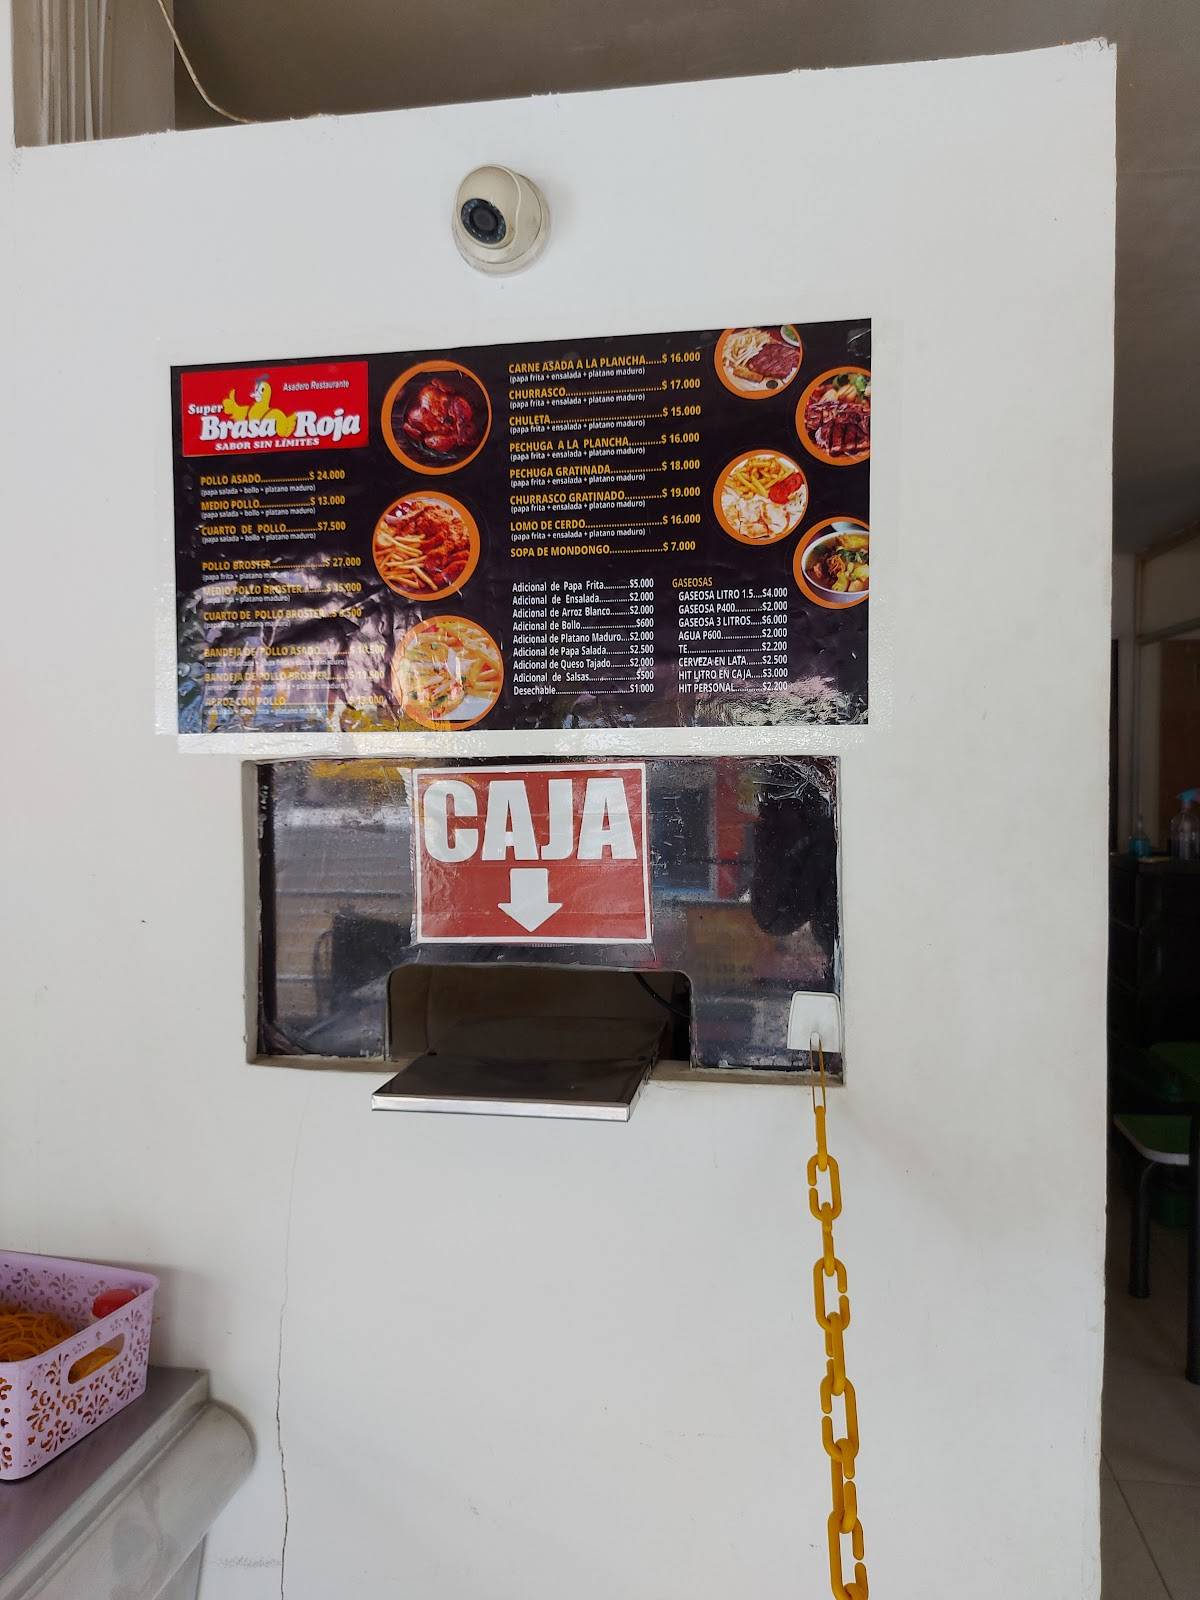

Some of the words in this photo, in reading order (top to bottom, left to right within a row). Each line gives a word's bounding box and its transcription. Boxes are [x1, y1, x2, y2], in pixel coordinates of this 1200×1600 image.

[509, 362, 541, 374] CARNE
[542, 360, 573, 372] ASADA
[576, 359, 584, 370] A
[586, 358, 598, 369] LA
[600, 355, 646, 368] PLANCHA
[670, 352, 701, 363] 16.000
[283, 383, 310, 392] Asadero
[311, 380, 350, 390] Restaurante
[509, 387, 566, 400] CHURRASCO
[670, 379, 701, 389] 17.000
[188, 404, 224, 415] Super
[509, 415, 551, 427] CHULETA
[671, 406, 702, 416] 15.000
[200, 415, 277, 441] Brasa
[294, 408, 360, 442] Roja
[215, 441, 252, 451] SABOR
[253, 440, 274, 449] SIN
[510, 441, 553, 453] PECHUGA
[558, 440, 564, 450] A
[567, 440, 579, 450] LA
[584, 436, 629, 449] PLANCHA
[669, 432, 700, 443] 16.000
[510, 467, 553, 479] PECHUGA
[555, 464, 611, 477] GRATINADA
[670, 460, 700, 470] 18.000
[200, 476, 229, 486] POLLO
[231, 474, 261, 485] ASADO
[317, 470, 346, 481] 24.000
[201, 501, 229, 511] MEDIO
[231, 500, 260, 510] POLLO
[318, 496, 346, 506] 13.000
[510, 494, 567, 506] CHURRASCO
[569, 491, 625, 503] GRATINADO
[670, 487, 701, 497] 19.000
[202, 526, 236, 536] CUARTO
[241, 525, 253, 533] DE
[258, 524, 286, 533] POLLO
[510, 521, 539, 532] LOMO
[540, 520, 553, 530] DE
[555, 519, 586, 529] CERDO
[671, 514, 701, 524] 16.000
[511, 548, 535, 558] SOPA
[537, 547, 549, 556] DE
[551, 545, 610, 556] MONDONGO
[671, 541, 696, 551] 7.000
[333, 558, 361, 567] 27.000
[512, 582, 547, 593] Adicional
[550, 580, 560, 592] de
[564, 581, 582, 593] Papa
[586, 580, 604, 590] Frita
[630, 578, 654, 589] $5.000
[672, 577, 713, 588] GASEOSAS
[512, 594, 547, 606] Adicional
[552, 594, 561, 605] de
[566, 593, 600, 604] Ensalada
[630, 592, 654, 602] $2.000
[678, 591, 715, 601] GASEOSA
[717, 590, 740, 600] LITRO
[742, 589, 753, 599] 1.5
[762, 588, 788, 598] $4.000
[513, 608, 547, 619] Adicional
[550, 607, 560, 617] de
[562, 608, 583, 617] Arroz
[585, 607, 611, 617] Blanco
[630, 605, 654, 615] $2.000
[678, 604, 715, 614] GASEOSA
[717, 603, 736, 613] P400
[762, 601, 788, 611] $2.000
[513, 620, 547, 632] Adicional
[550, 620, 560, 630] de
[562, 620, 582, 630] Bollo
[636, 618, 654, 628] $600
[678, 617, 715, 628] GASEOSA
[716, 617, 721, 627] 3
[723, 616, 751, 626] LITROS
[762, 614, 788, 624] $6.000
[513, 634, 547, 644] Adicional
[550, 633, 559, 643] de
[561, 633, 590, 643] Platano
[592, 632, 622, 642] Maduro
[630, 631, 654, 641] $2.000
[678, 631, 701, 641] AGUA
[703, 631, 722, 640] P600
[762, 629, 788, 638] $2.000
[513, 647, 547, 657] Adicional
[550, 646, 559, 656] de
[561, 647, 580, 658] Papa
[582, 646, 607, 656] Salada
[630, 644, 654, 654] $2.500
[678, 644, 688, 654] TE
[762, 641, 787, 651] $2.200
[513, 660, 547, 670] Adicional
[550, 660, 559, 669] de
[561, 659, 584, 670] Queso
[586, 658, 611, 670] Tajado
[630, 658, 654, 667] $2.000
[678, 657, 713, 667] CERVEZA
[715, 657, 726, 666] EN
[727, 656, 747, 665] LATA
[762, 655, 788, 664] $2.500
[514, 673, 548, 683] Adicional
[552, 672, 562, 682] de
[566, 672, 590, 682] Salsas
[636, 670, 654, 680] $500
[679, 671, 692, 680] HIT
[694, 670, 717, 680] LITRO
[719, 670, 730, 679] EN
[763, 668, 788, 678] $3.000
[514, 685, 556, 696] Desechable
[630, 684, 654, 693] $1.000
[679, 684, 692, 693] HIT
[694, 683, 736, 693] PERSONAL
[763, 681, 788, 691] $2.200
[422, 777, 640, 864] CAJA
